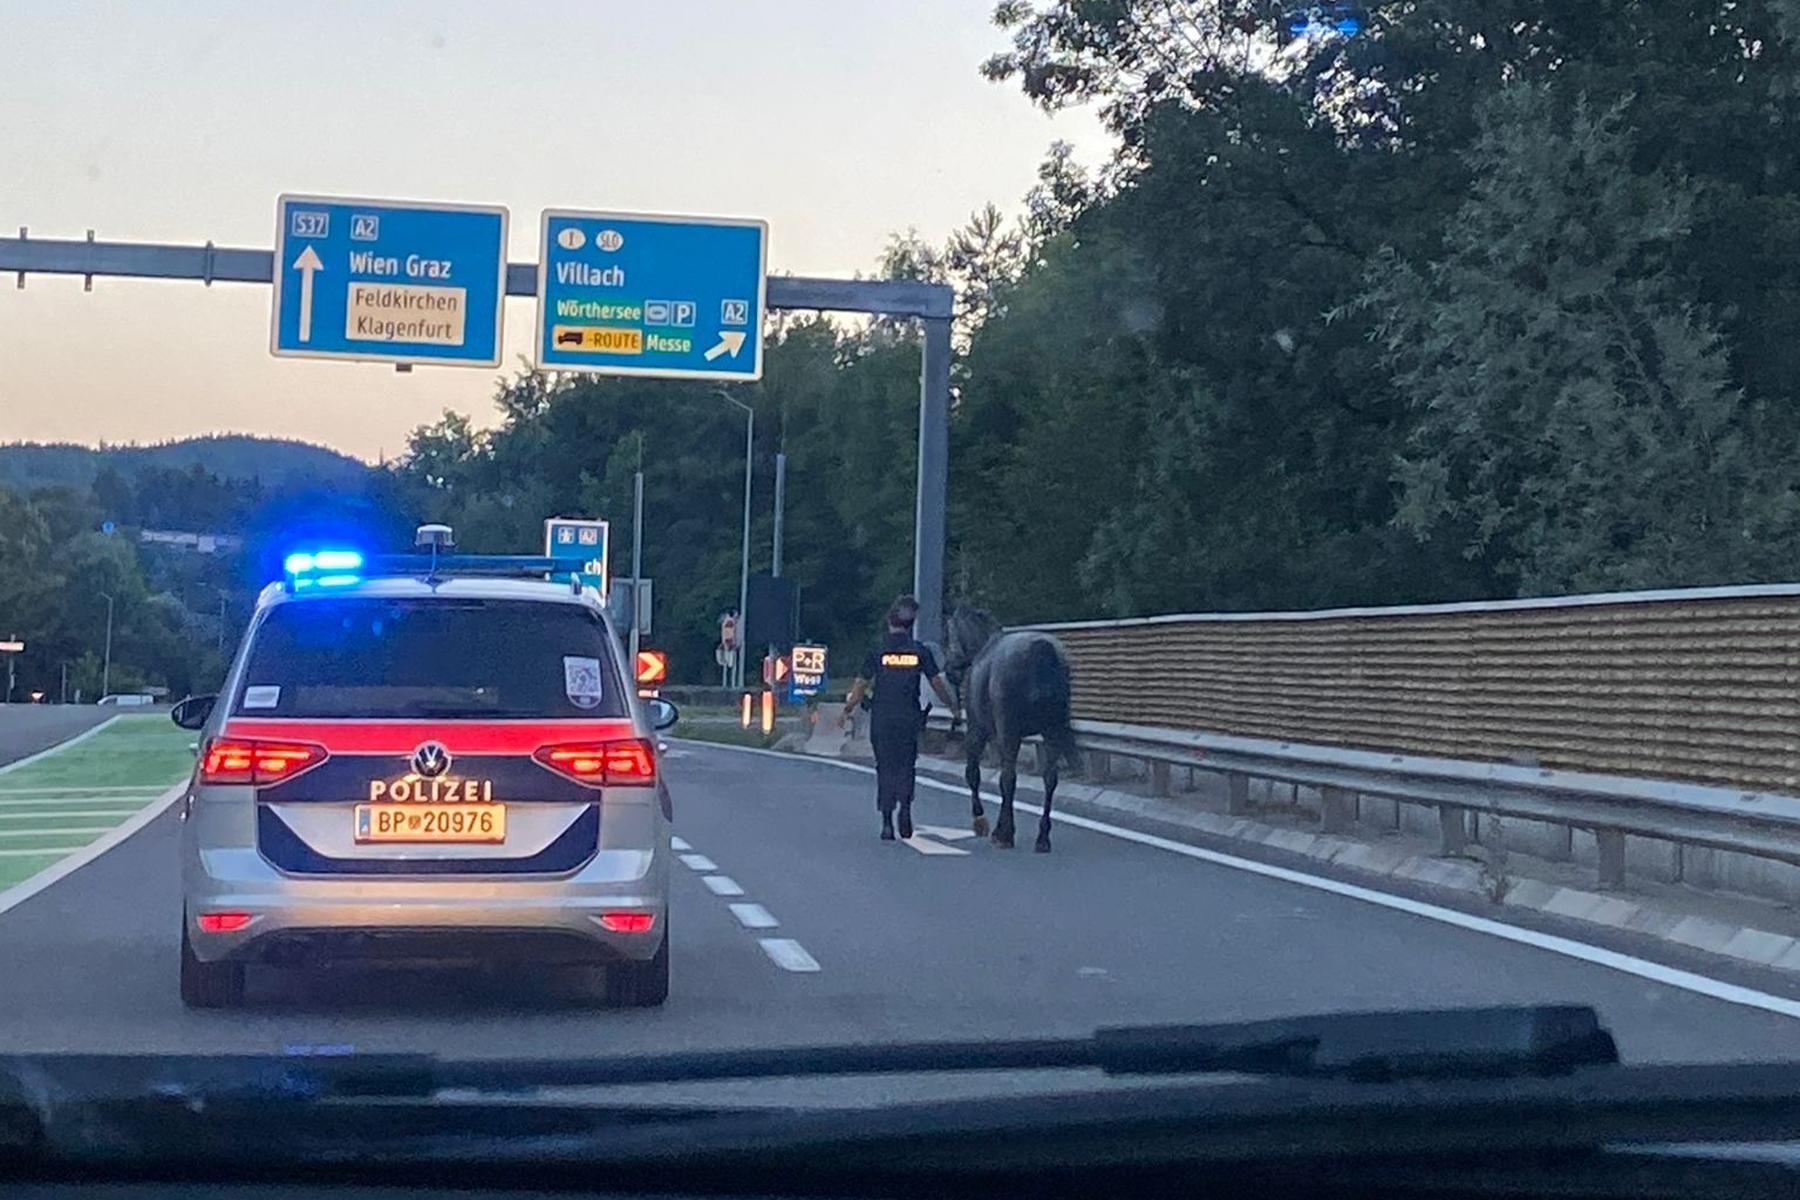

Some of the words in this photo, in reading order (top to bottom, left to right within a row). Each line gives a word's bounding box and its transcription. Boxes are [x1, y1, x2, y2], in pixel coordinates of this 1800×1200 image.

[296, 215, 326, 235] S37
[355, 219, 375, 237] A2
[599, 233, 619, 249] SLO
[350, 251, 398, 276] Wien
[405, 254, 452, 279] Graz
[556, 261, 625, 287] Villach
[355, 288, 458, 312] Feldkirchen
[557, 299, 641, 321] Wörthersee
[676, 304, 690, 323] P
[724, 304, 744, 322] A2
[357, 315, 453, 340] Klagenfurt
[646, 333, 692, 353] Messe
[881, 653, 919, 667] POLIZEI
[370, 779, 492, 802] POLIZEI
[378, 811, 406, 833] BP
[424, 811, 493, 833] 20976
